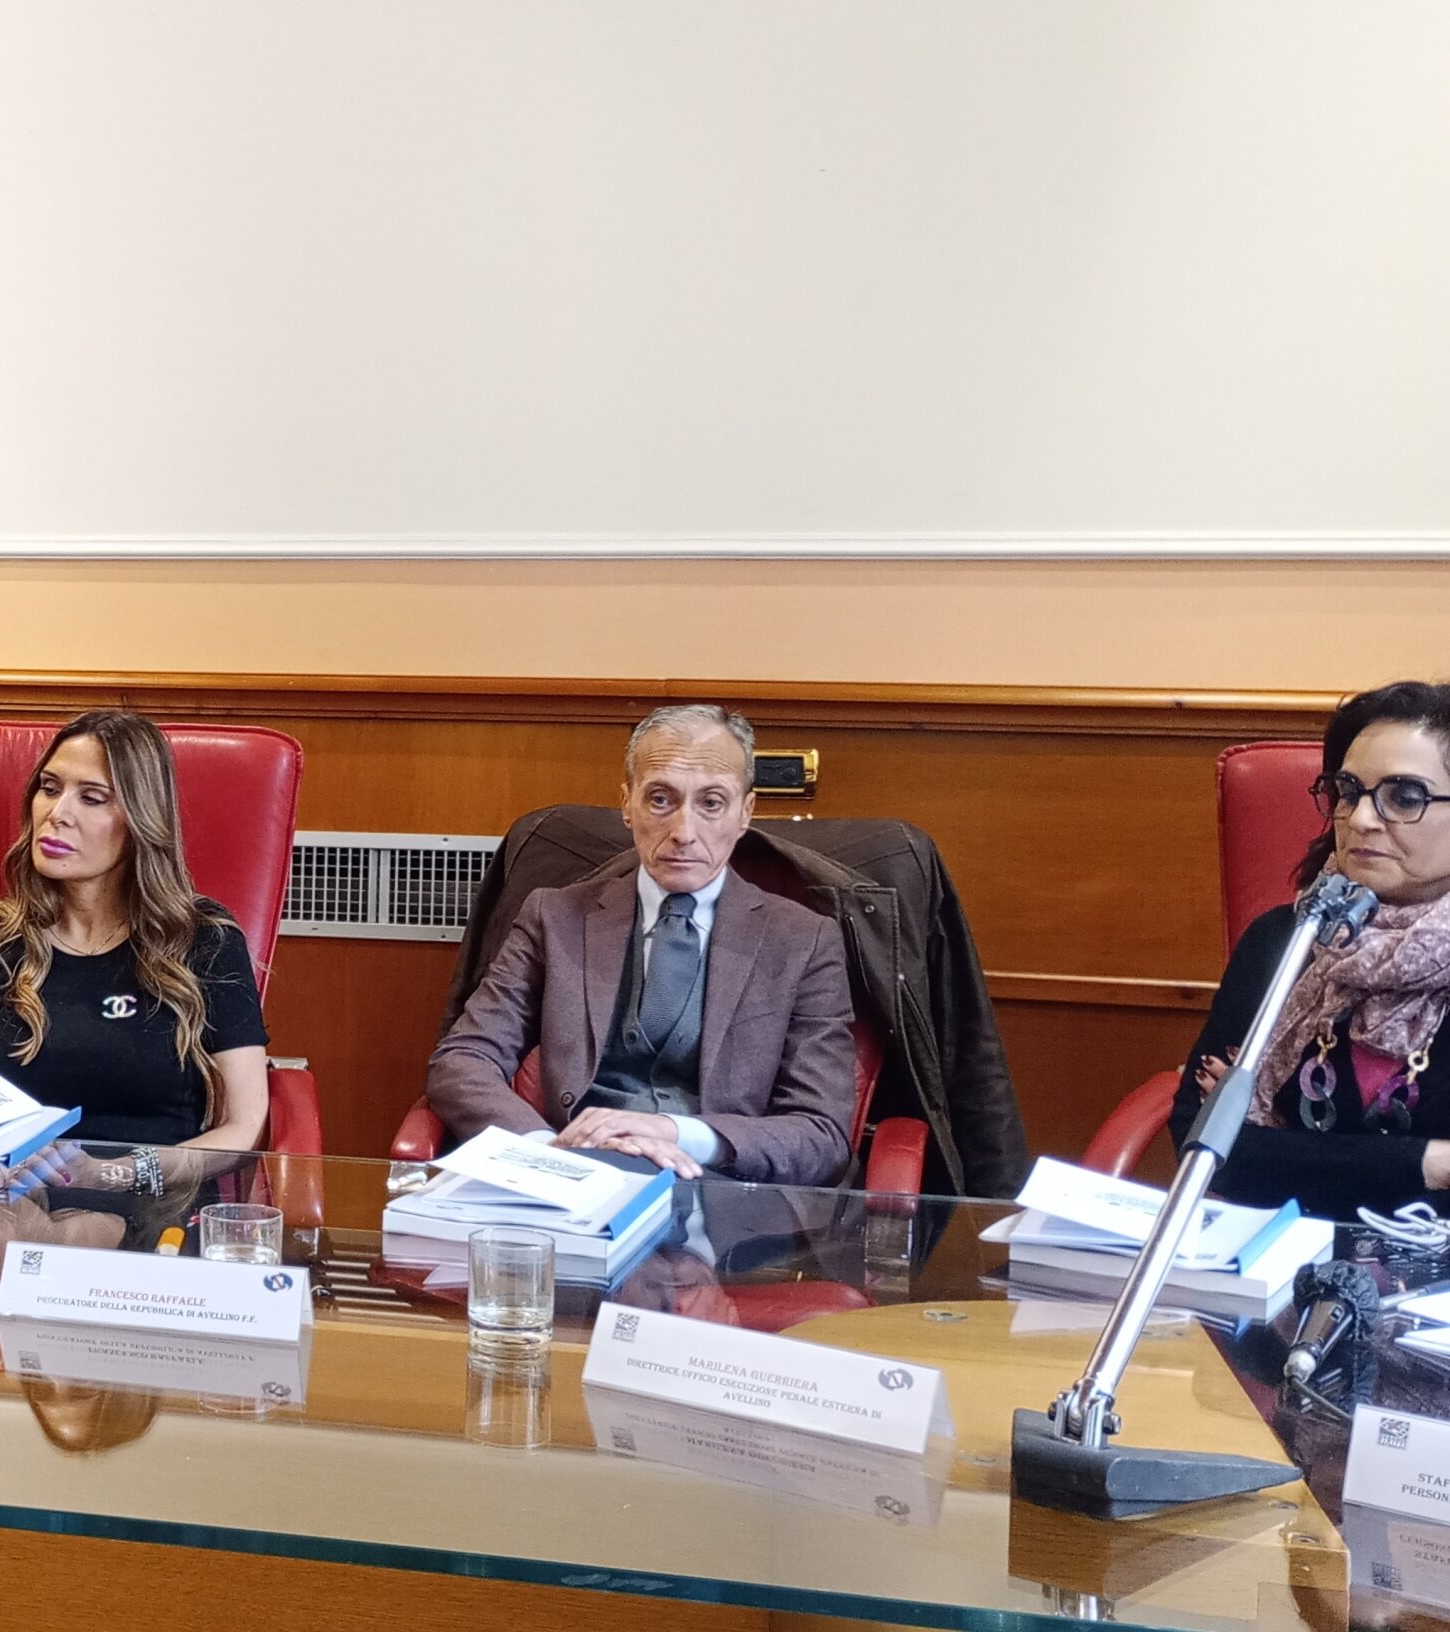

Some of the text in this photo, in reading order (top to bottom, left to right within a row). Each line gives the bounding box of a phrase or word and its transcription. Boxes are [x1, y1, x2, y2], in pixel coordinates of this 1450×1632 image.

[37, 1296, 99, 1308] PROCURATORE
[100, 1302, 127, 1311] DELLA
[130, 1305, 184, 1317] REPUBBLICA
[186, 1309, 195, 1318] DI
[196, 1311, 240, 1321] AVELLINO
[89, 1288, 206, 1307] FRANCESCO RAFFAELE
[688, 1356, 818, 1393] MARILENA GUERRIERA
[626, 1358, 882, 1420] DIRETTRICE UFFICIO ESECUZIONE PENALE ESTERNA DI
[722, 1391, 771, 1408] AVELLINO
[1402, 1484, 1450, 1503] PERSON
